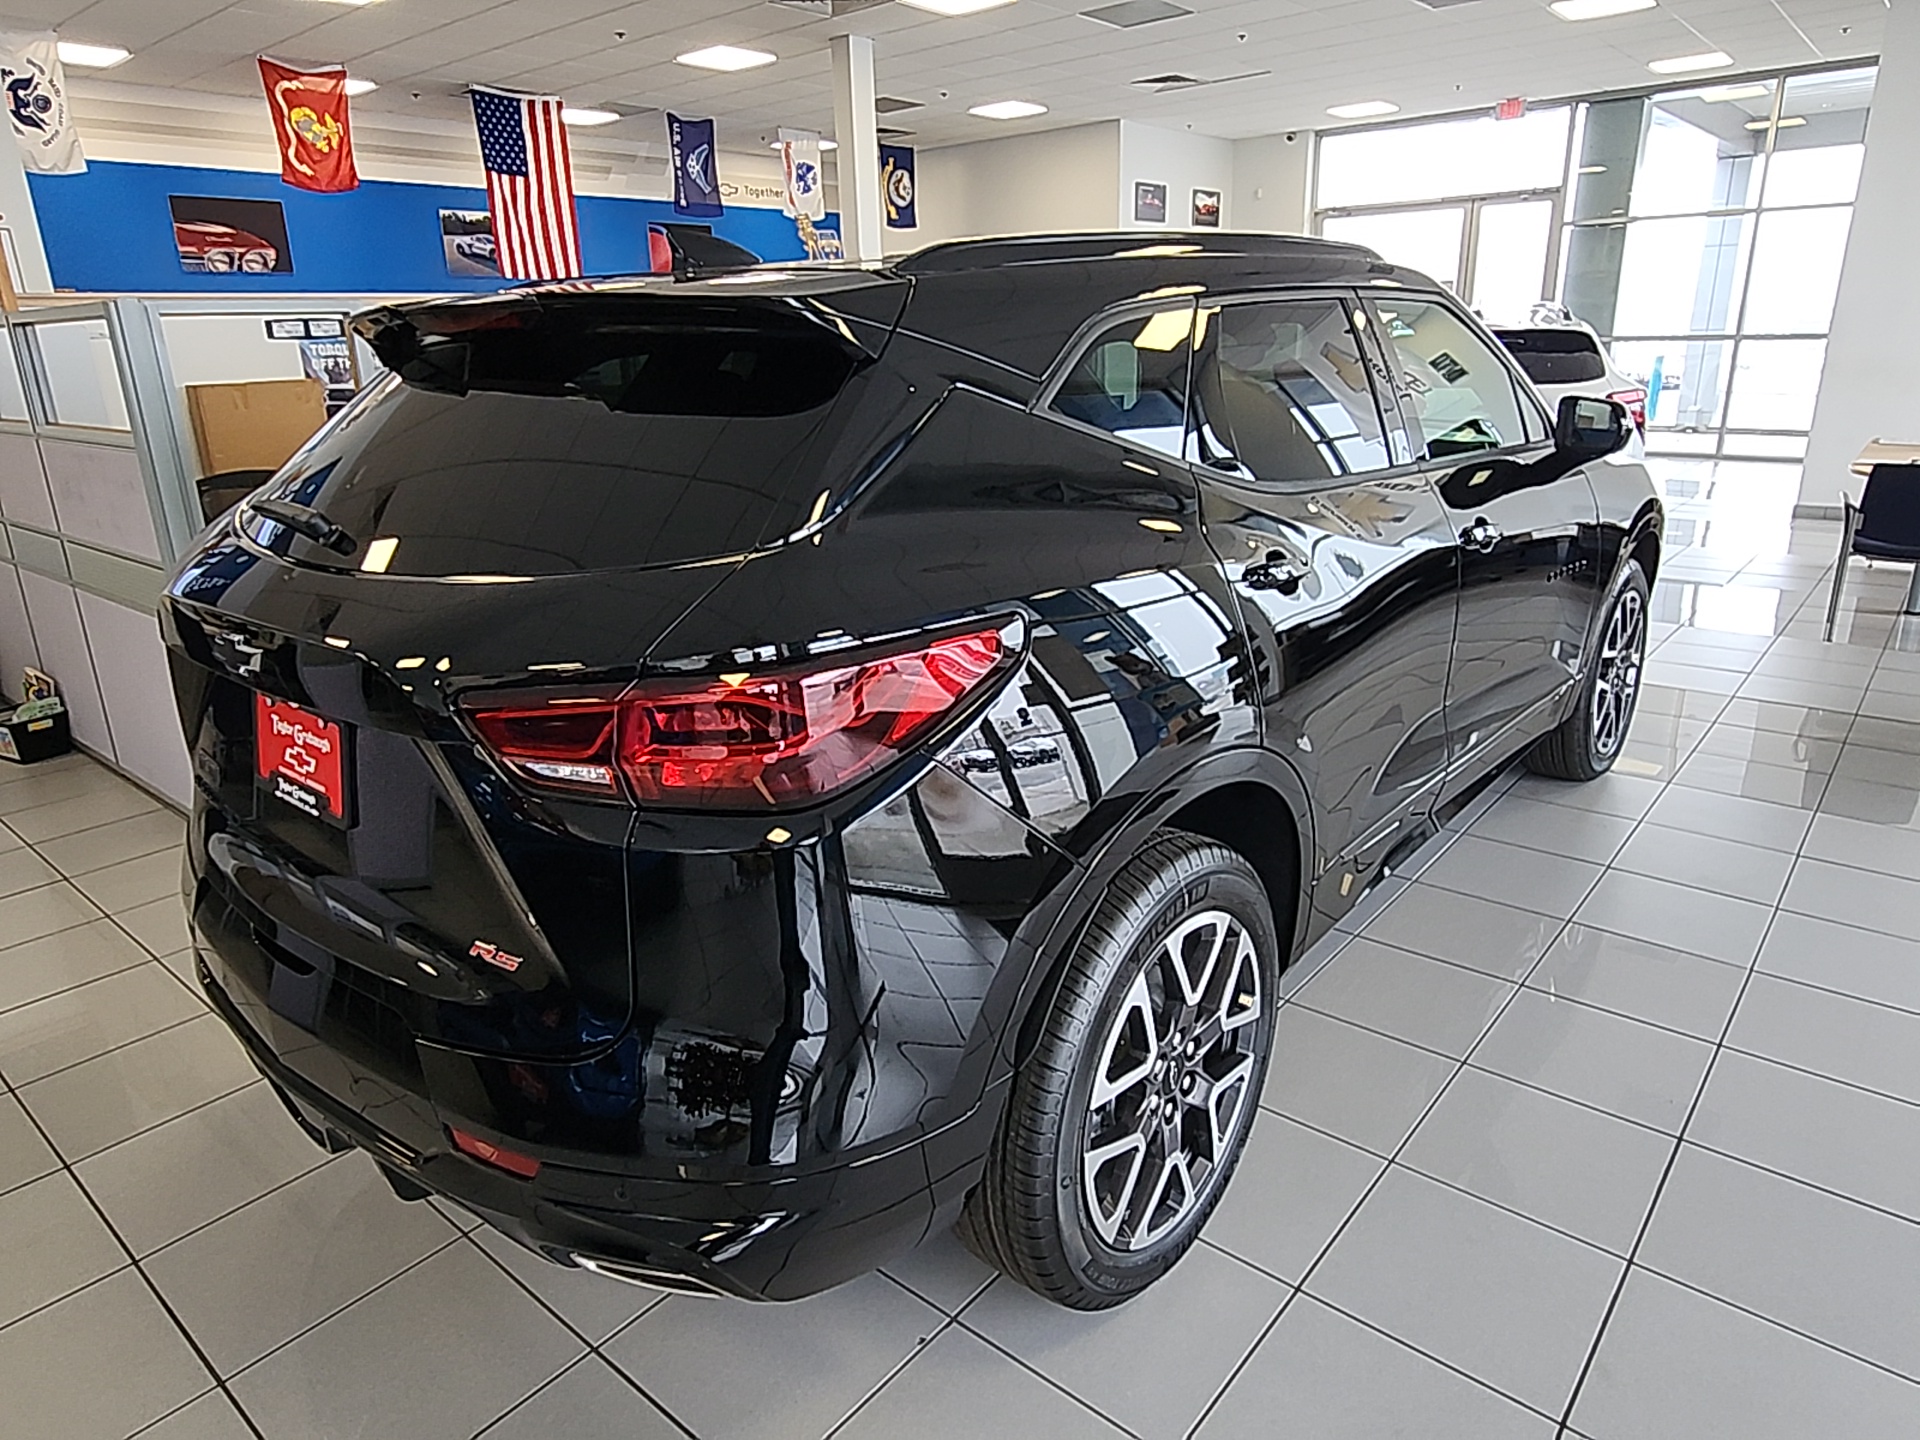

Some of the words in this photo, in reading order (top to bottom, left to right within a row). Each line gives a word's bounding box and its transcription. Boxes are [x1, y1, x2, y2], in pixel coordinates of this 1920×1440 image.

[743, 184, 785, 199] Together
[1137, 882, 1208, 960] MICHEIN
[468, 939, 525, 972] RS
